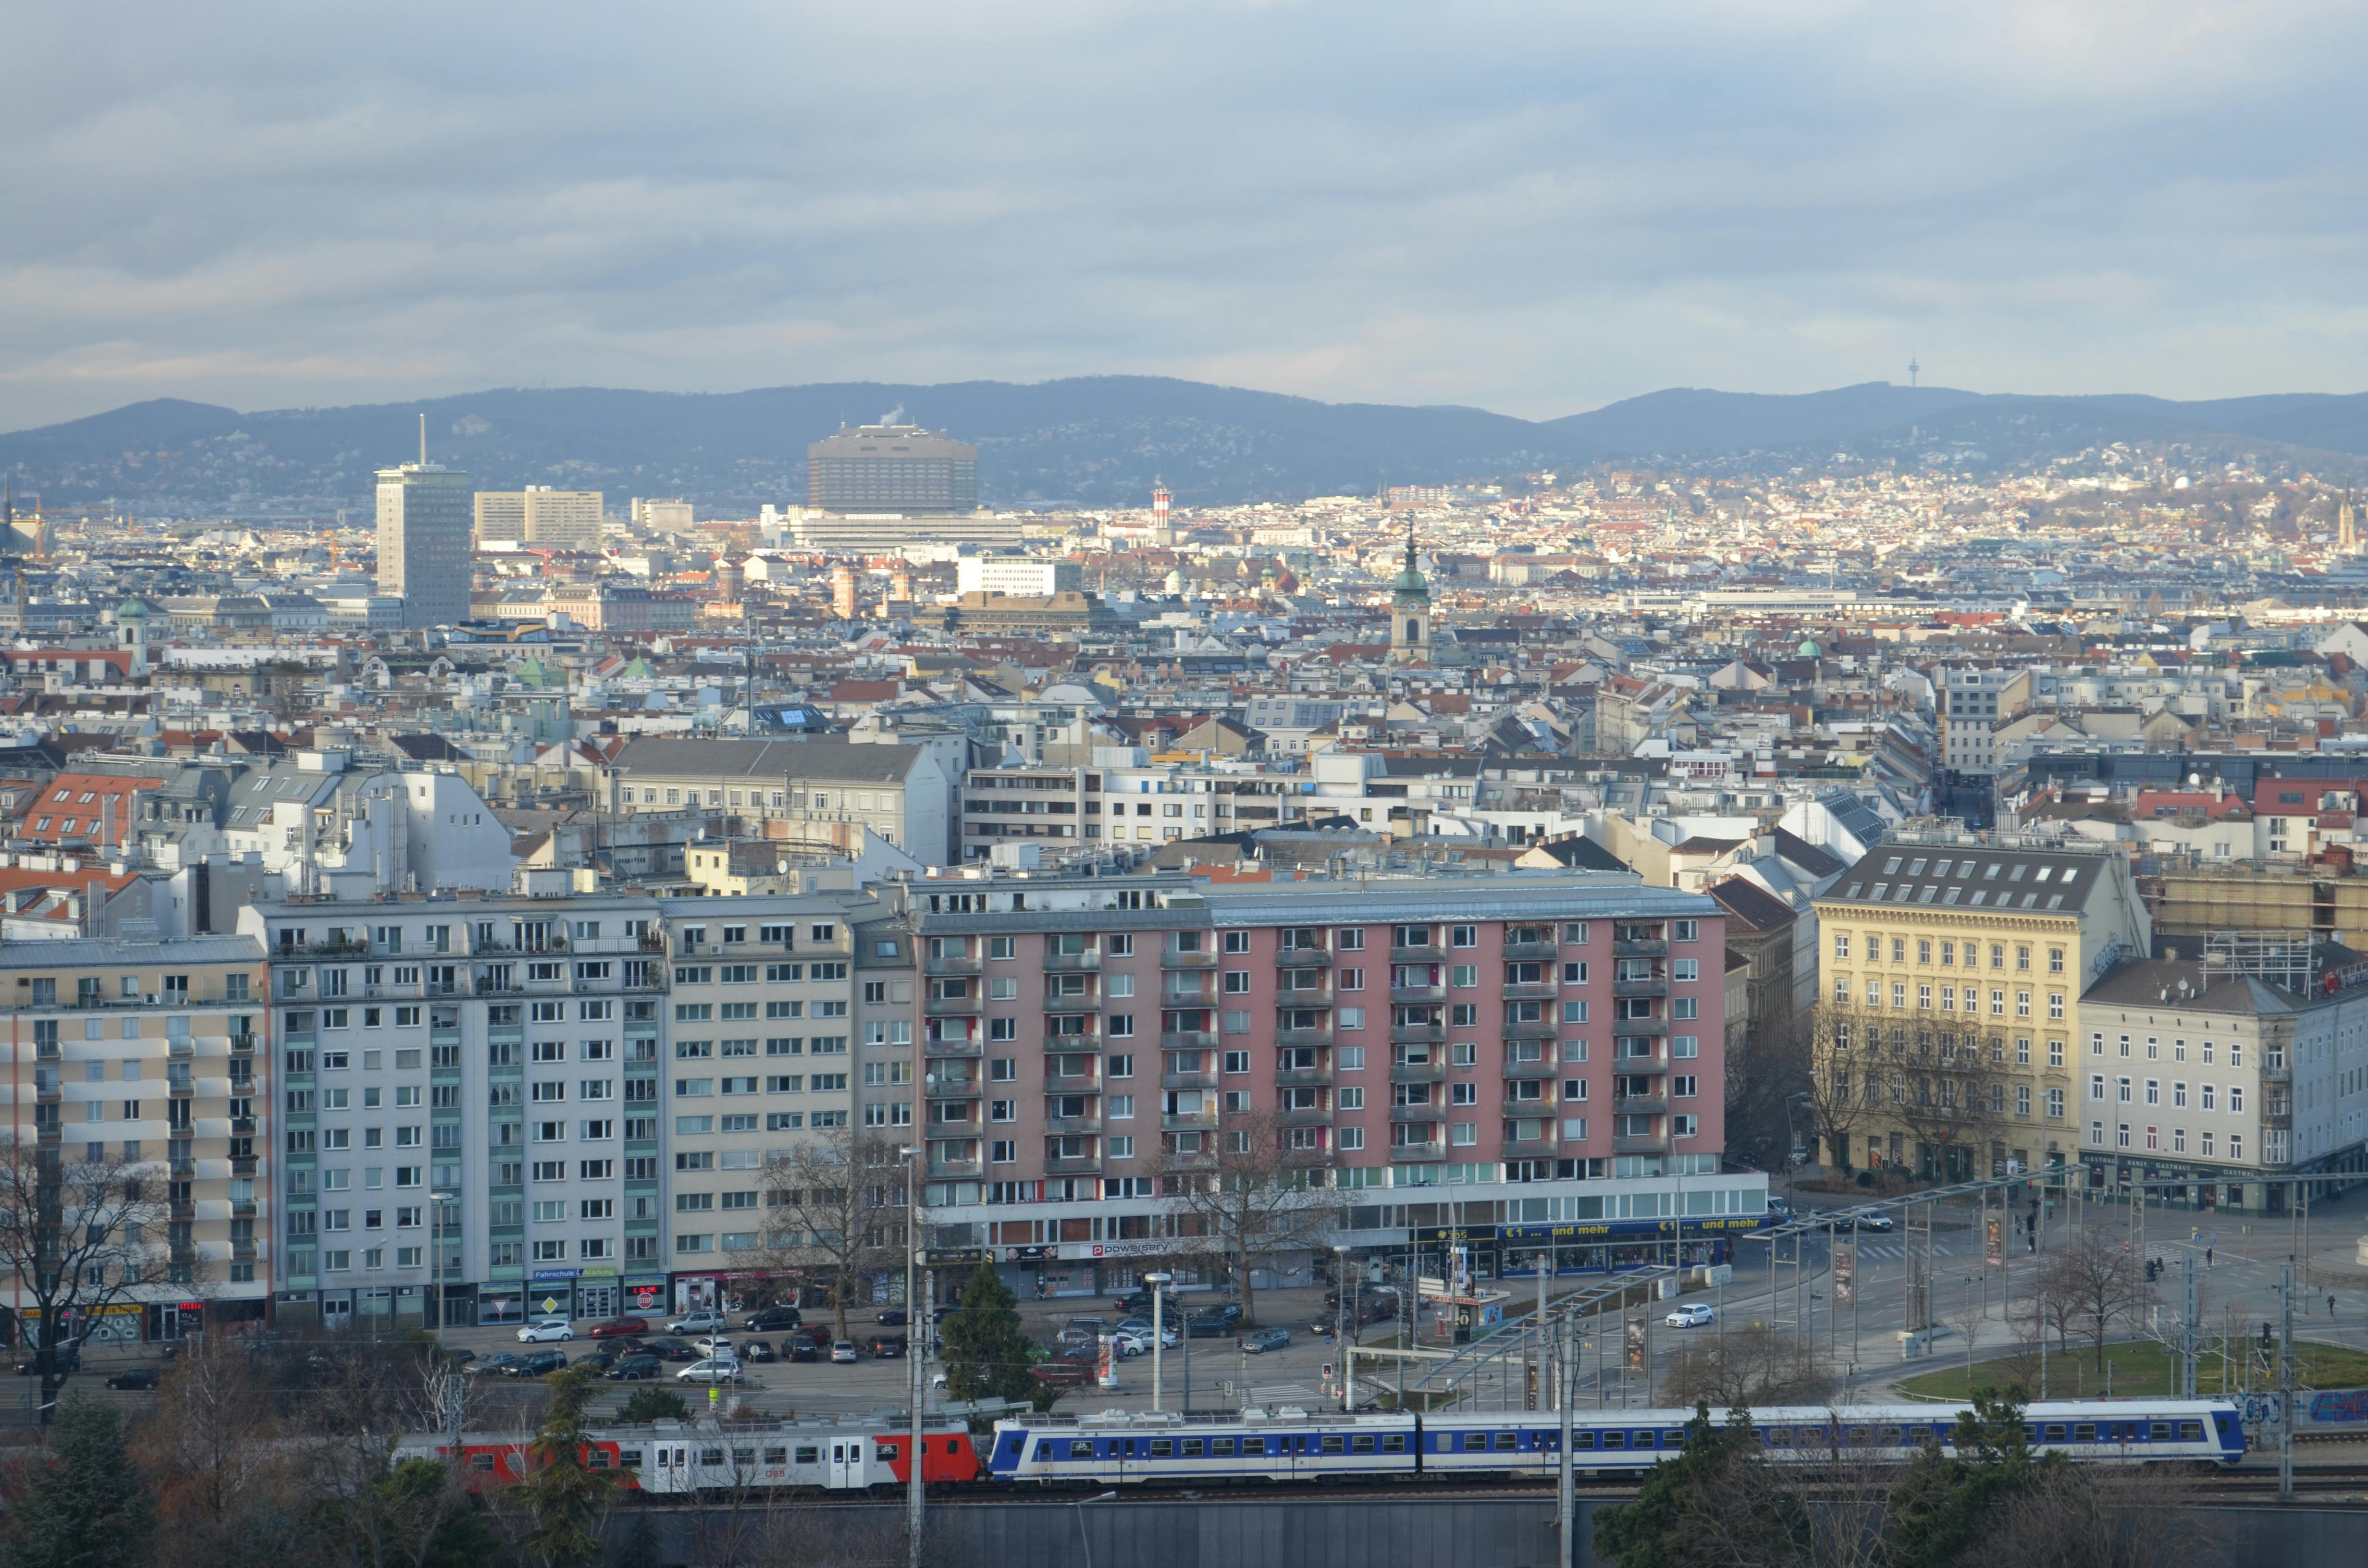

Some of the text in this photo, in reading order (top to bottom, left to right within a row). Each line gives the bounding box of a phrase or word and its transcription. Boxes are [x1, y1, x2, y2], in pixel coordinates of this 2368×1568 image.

[2156, 1163, 2191, 1171] GASTHAUS
[2223, 1169, 2258, 1177] GASTHAU
[1702, 1220, 1725, 1229] und
[1728, 1218, 1760, 1228] mehr
[1552, 1226, 1574, 1236] und
[1578, 1225, 1610, 1235] mehr
[1105, 1243, 1169, 1254] powerserv
